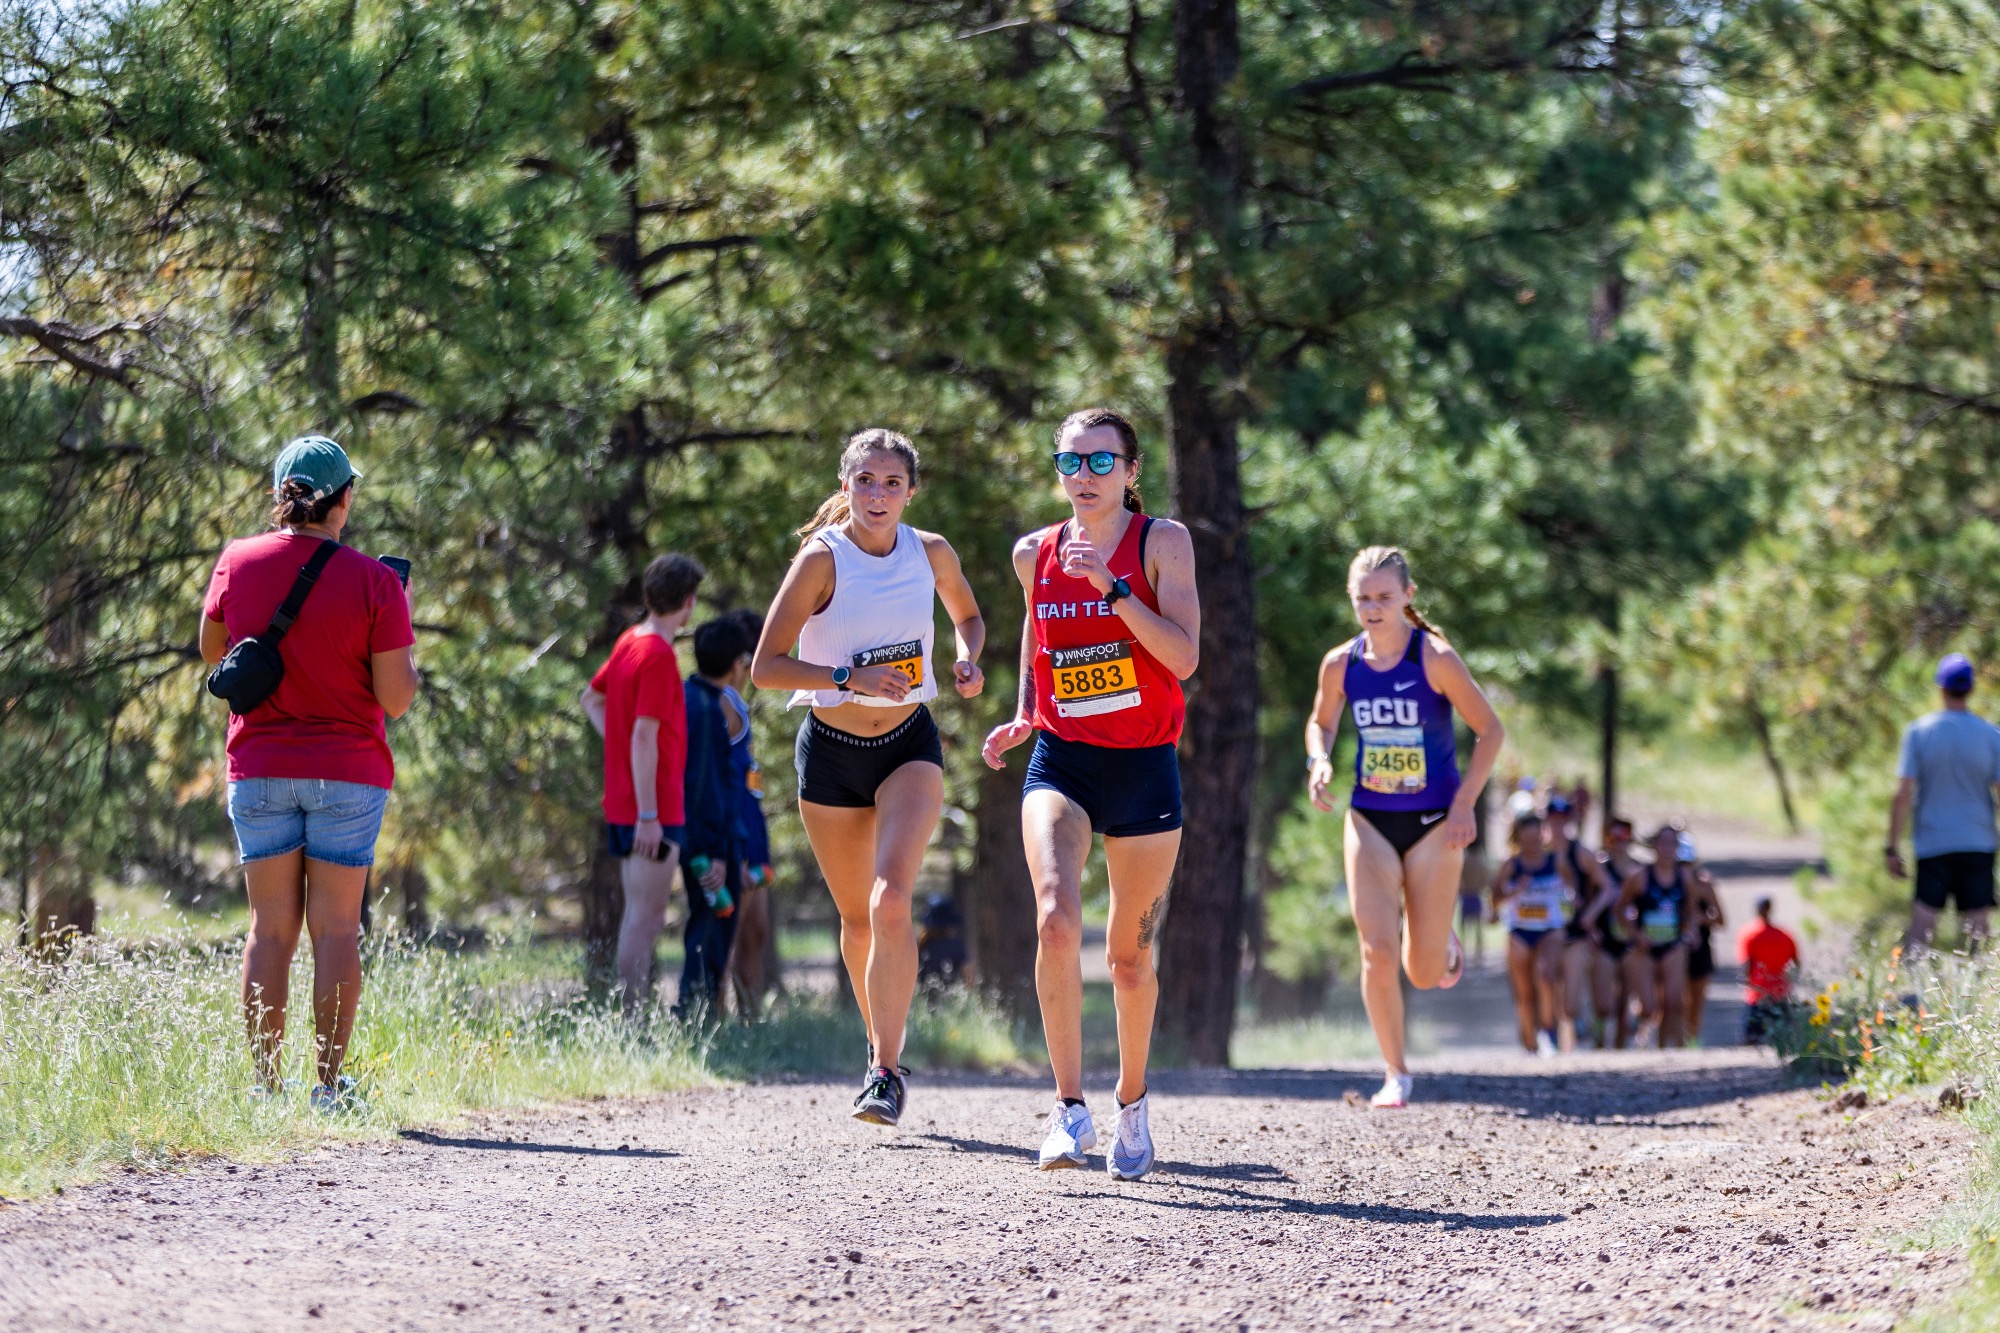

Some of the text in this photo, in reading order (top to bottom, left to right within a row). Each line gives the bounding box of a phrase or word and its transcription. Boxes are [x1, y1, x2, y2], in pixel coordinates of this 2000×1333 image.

[1082, 601, 1118, 617] TE
[872, 642, 917, 659] WINGFOOT
[1064, 642, 1120, 660] WINGFOOT
[1061, 665, 1124, 695] 5883
[1352, 697, 1419, 727] GCU
[826, 730, 904, 747] ARMOUR ARMOUR
[1366, 752, 1420, 772] 3456
